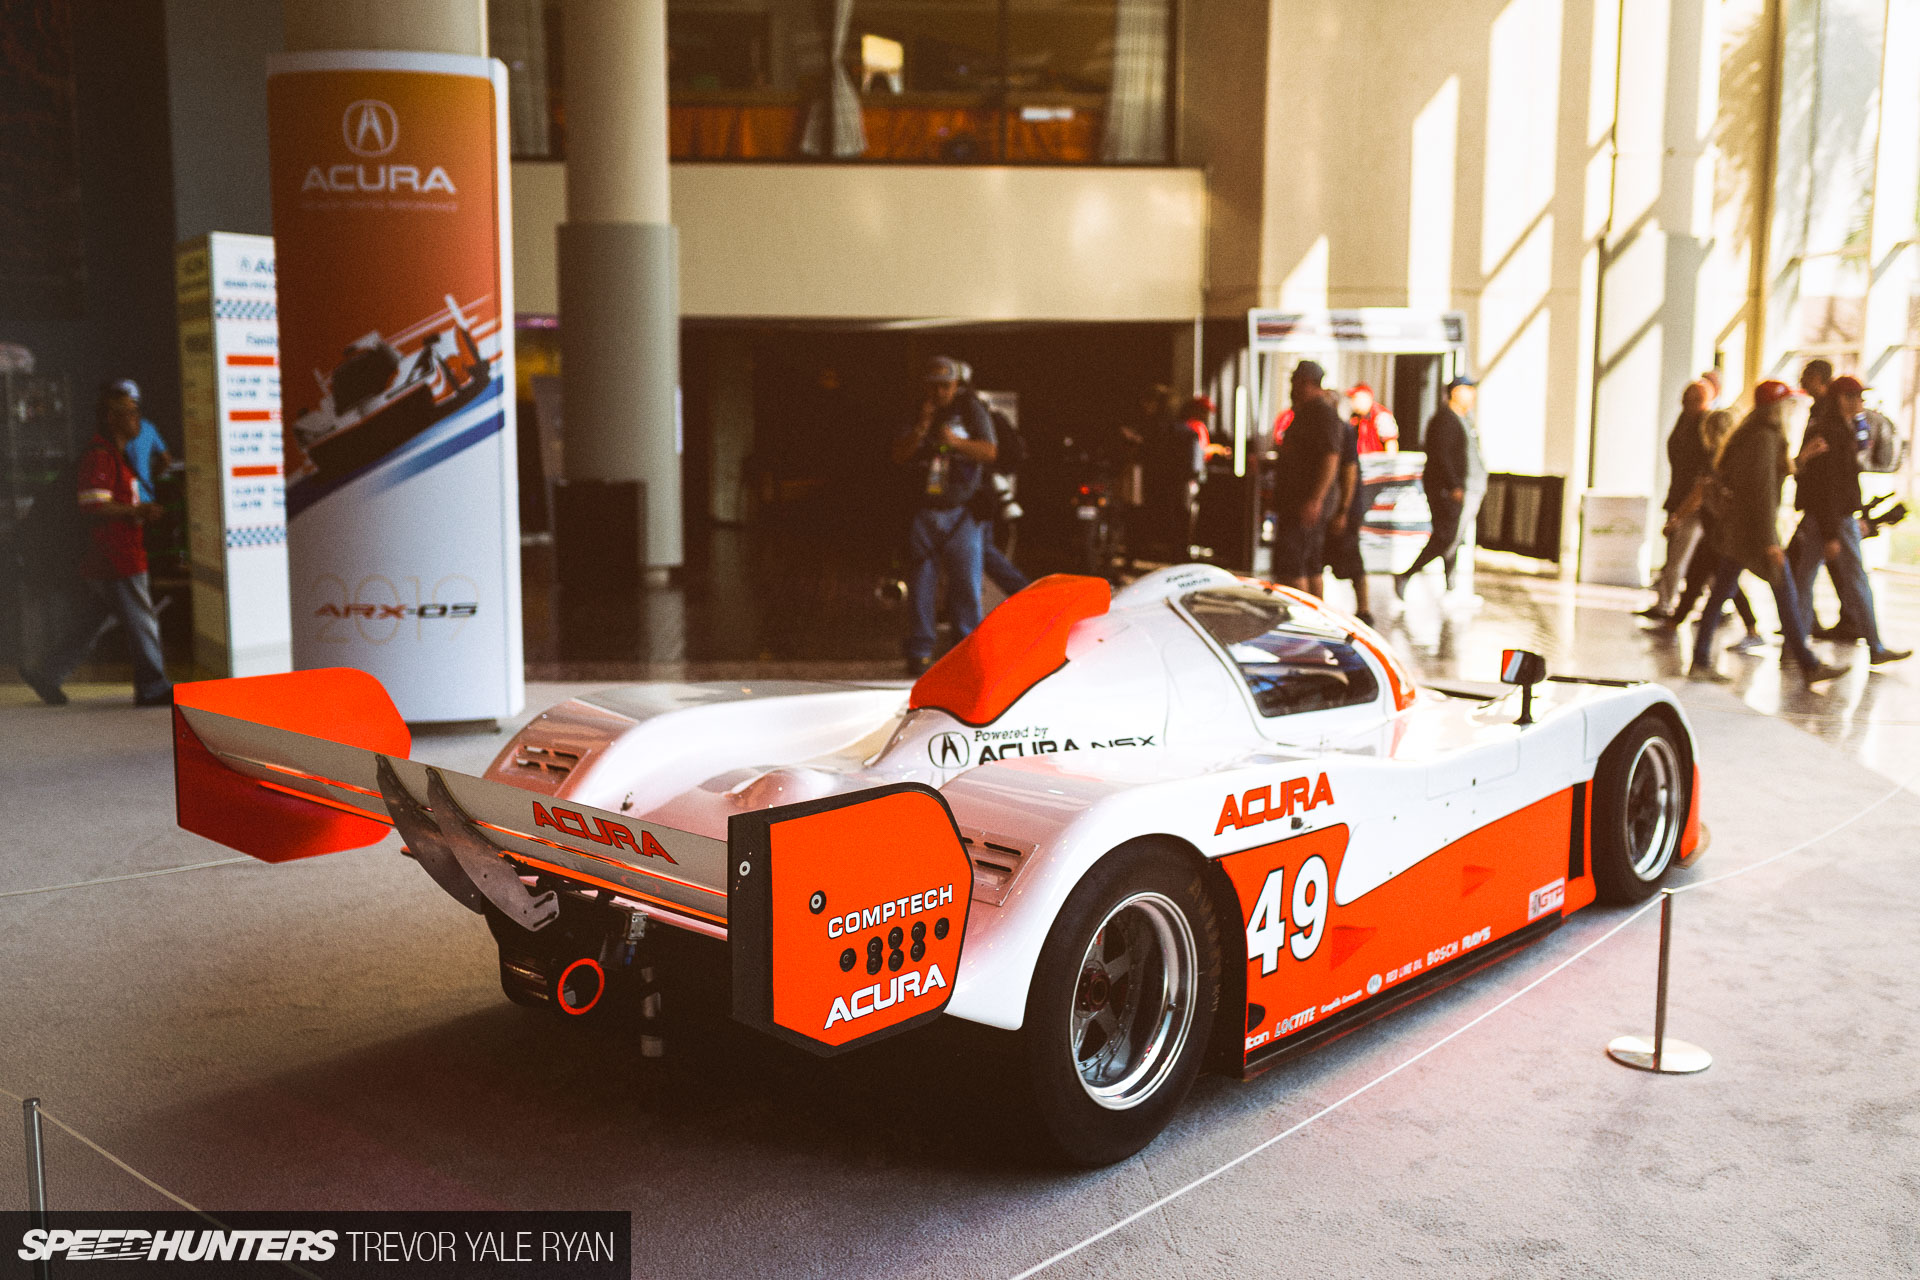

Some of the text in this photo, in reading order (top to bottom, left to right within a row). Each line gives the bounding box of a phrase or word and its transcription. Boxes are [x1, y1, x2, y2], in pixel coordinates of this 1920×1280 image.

[302, 165, 457, 194] ACURA
[315, 602, 478, 620] ARX-05
[975, 725, 1049, 742] Powered by
[979, 738, 1080, 766] ACURA
[532, 801, 680, 866] ACURA
[1214, 772, 1335, 836] ACURA
[828, 883, 953, 940] COMPTECH
[1246, 853, 1330, 979] 49
[823, 963, 948, 1031] ACURA
[1274, 1006, 1317, 1039] LOCTITE
[1426, 940, 1459, 967] BOSCH
